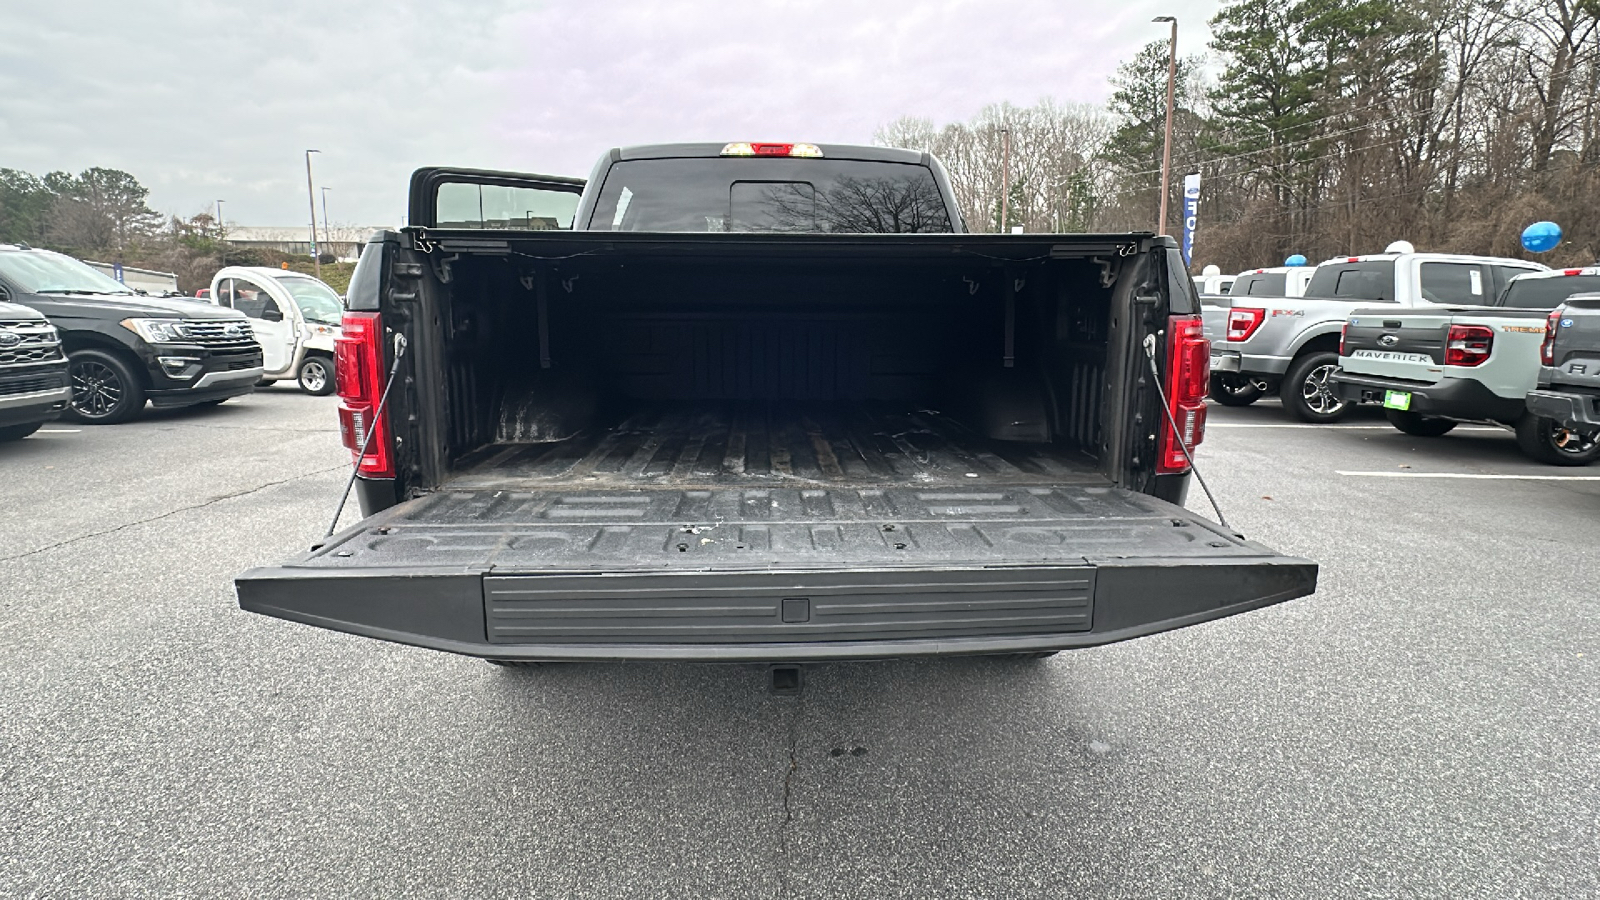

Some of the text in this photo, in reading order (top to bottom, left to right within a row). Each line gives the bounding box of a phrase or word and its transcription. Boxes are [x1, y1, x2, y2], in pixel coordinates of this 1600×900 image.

[1272, 309, 1305, 317] FX4
[1356, 350, 1428, 363] MAVERICK
[1567, 363, 1600, 376] R
